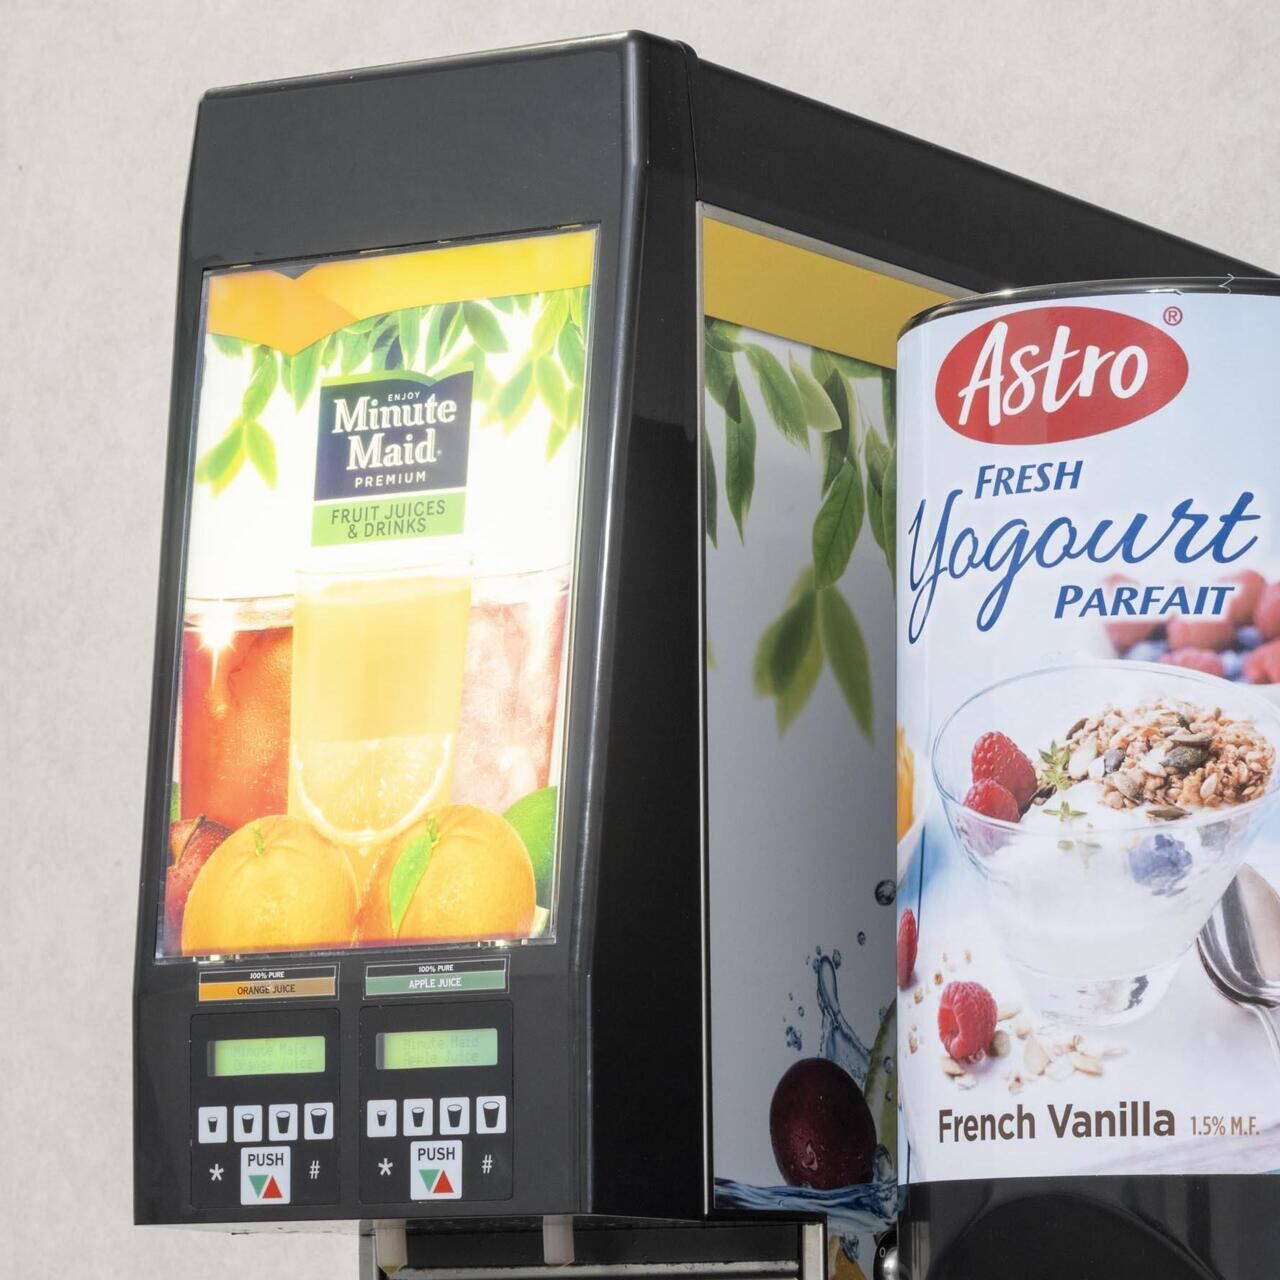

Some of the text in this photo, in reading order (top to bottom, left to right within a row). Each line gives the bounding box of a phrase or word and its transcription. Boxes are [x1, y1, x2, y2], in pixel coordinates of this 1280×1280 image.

[958, 321, 1148, 426] Astro
[388, 391, 420, 402] ENJOY
[332, 395, 456, 434] Minute
[346, 429, 437, 470] Maid
[355, 471, 426, 488] PREMIUM
[975, 460, 1084, 499] FRESH
[331, 500, 446, 525] FRUIT JUICES
[348, 518, 426, 539] & DRINKS
[908, 490, 1261, 644] Yogourt
[1054, 584, 1235, 618] PARFAIT
[237, 984, 296, 995] ORANGE JUICE
[409, 977, 462, 989] APPLE JUICE
[938, 1101, 1260, 1143] French Vanilla 1.5% M.F.
[248, 1153, 284, 1167] PUSH
[418, 1147, 455, 1161] PUSH
